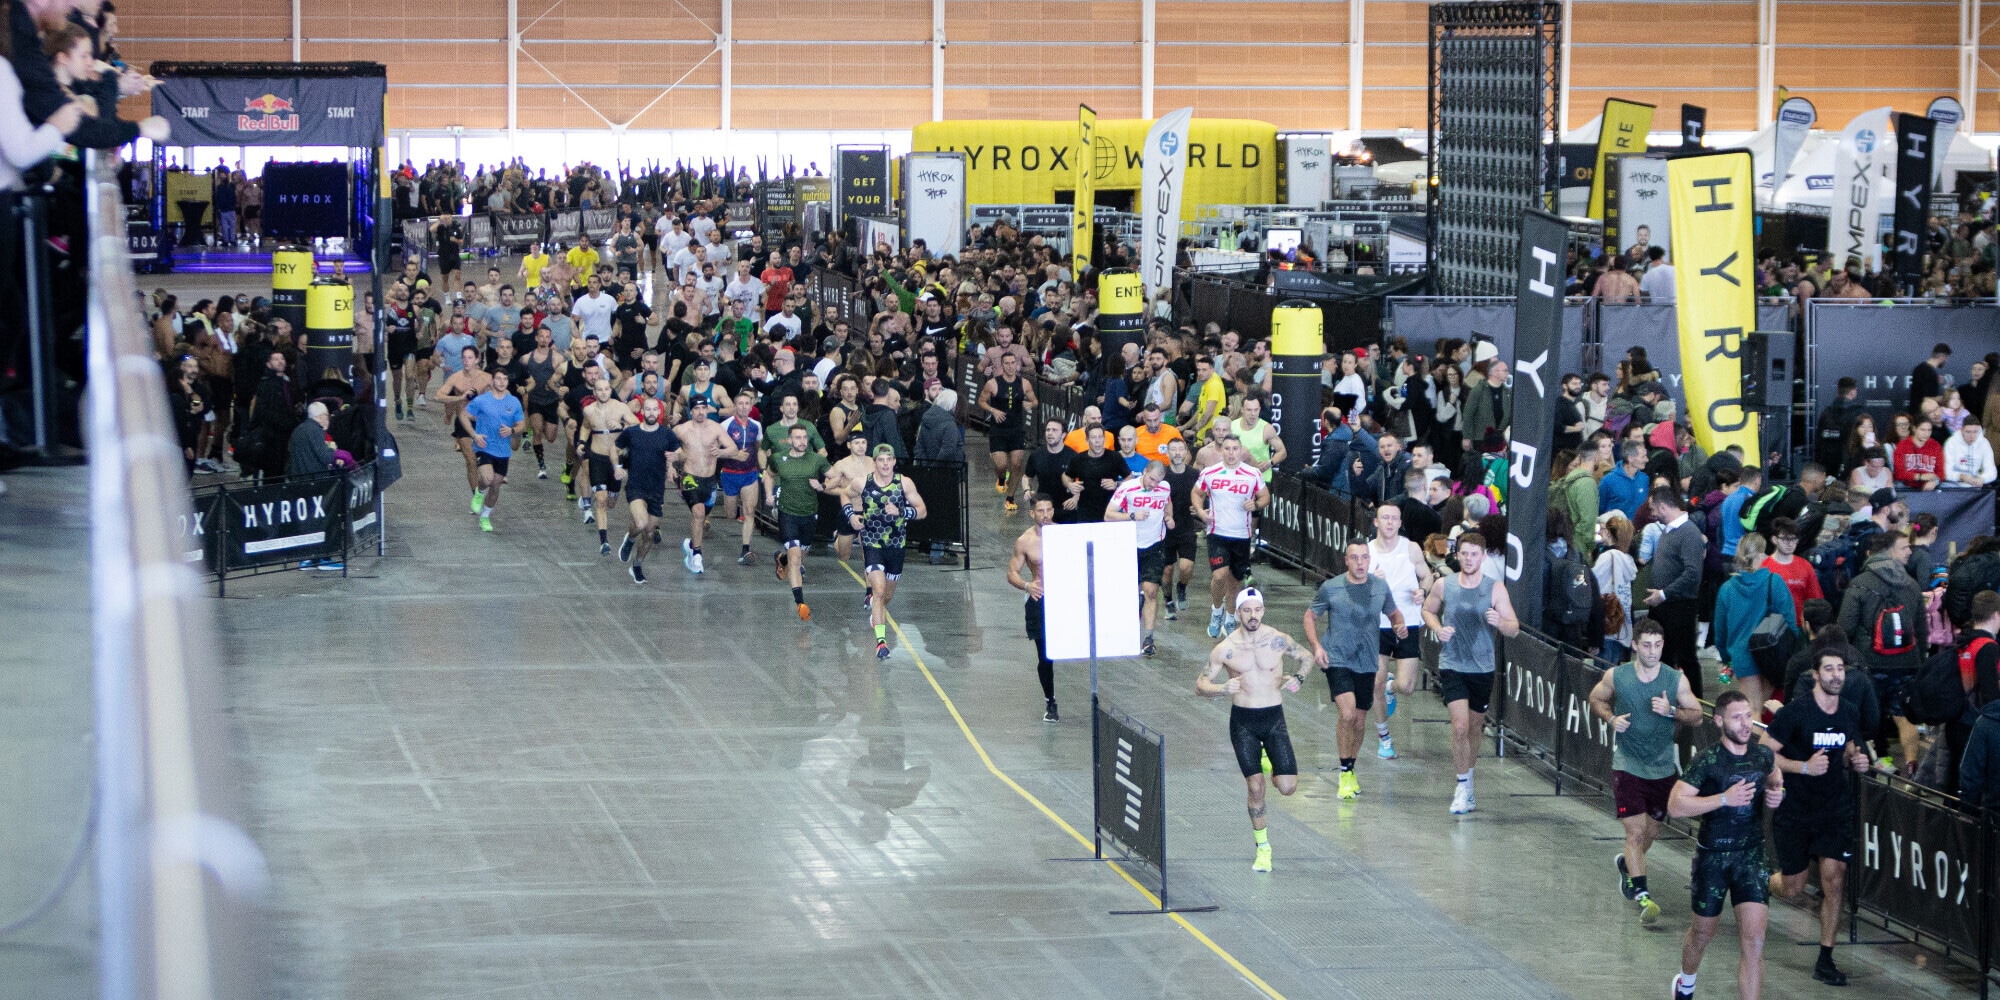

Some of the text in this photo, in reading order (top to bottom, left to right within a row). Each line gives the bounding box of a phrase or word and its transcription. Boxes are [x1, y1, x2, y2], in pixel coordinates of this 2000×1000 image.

[181, 106, 210, 118] START
[327, 106, 355, 118] START
[238, 114, 299, 131] Red Bull
[936, 144, 1069, 171] YROX
[1124, 143, 1261, 170] WRLD
[853, 177, 876, 187] GET
[279, 194, 332, 204] HYROX
[848, 195, 880, 204] YOUR
[503, 218, 539, 231] HYROX
[1154, 161, 1175, 288] OMPEX
[125, 235, 158, 248] YROX
[274, 263, 297, 275] TRY
[1115, 285, 1143, 298] ENT
[334, 299, 352, 311] EX
[1211, 478, 1249, 495] SP40
[1133, 496, 1164, 510] SP40
[243, 494, 326, 529] HYROX
[1306, 510, 1349, 553] HYROX
[1812, 732, 1846, 747] HWPO
[1863, 821, 1970, 909] HYROX
